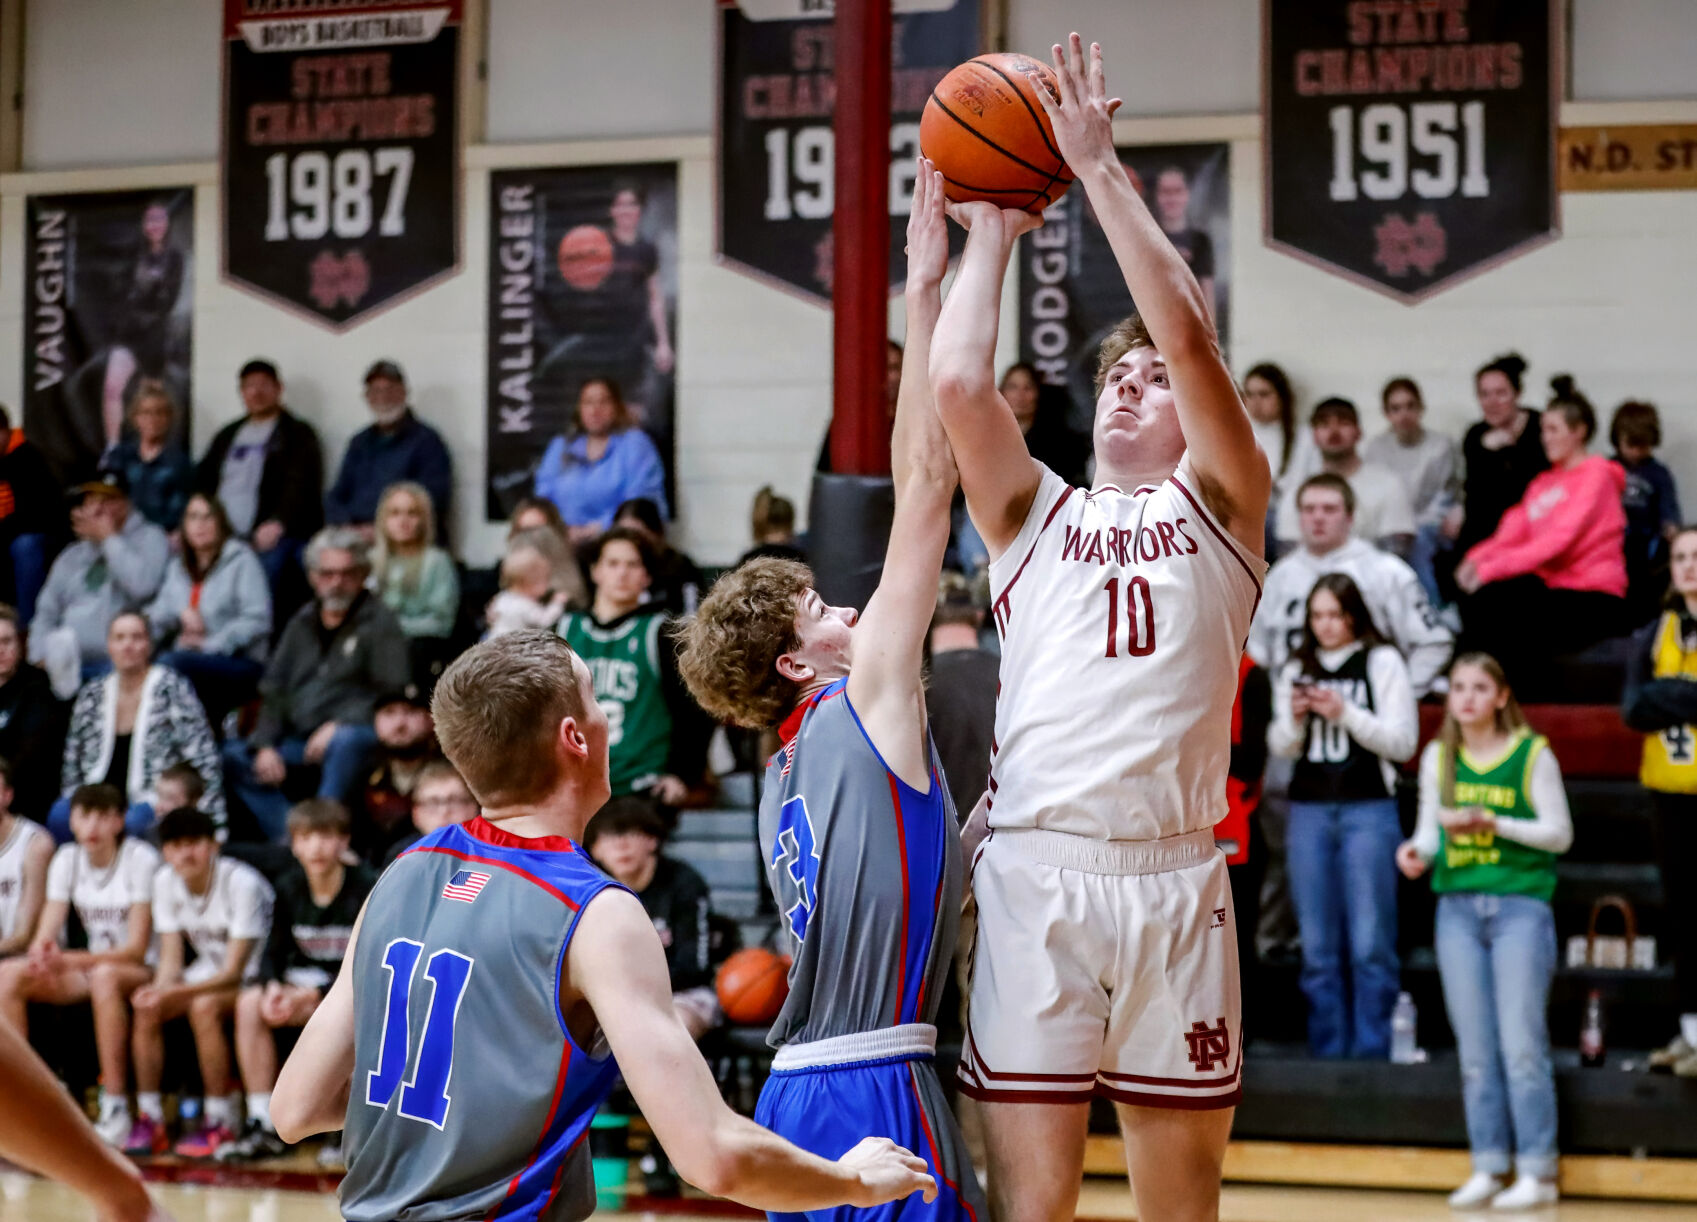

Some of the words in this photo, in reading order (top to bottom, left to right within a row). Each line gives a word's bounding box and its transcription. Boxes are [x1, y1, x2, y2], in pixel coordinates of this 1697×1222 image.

[1347, 0, 1470, 44] STATE
[291, 51, 392, 97] STATE
[1294, 42, 1523, 96] CHAMPIONS
[247, 93, 435, 146] CHAMPIONS
[1329, 101, 1490, 201] 1951
[265, 147, 414, 241] 1987
[34, 210, 66, 391] VAUGHN
[500, 183, 534, 434] KALLINGER
[1061, 518, 1198, 567] WARRIORS
[1104, 575, 1156, 658] 10
[365, 937, 474, 1131] 11
